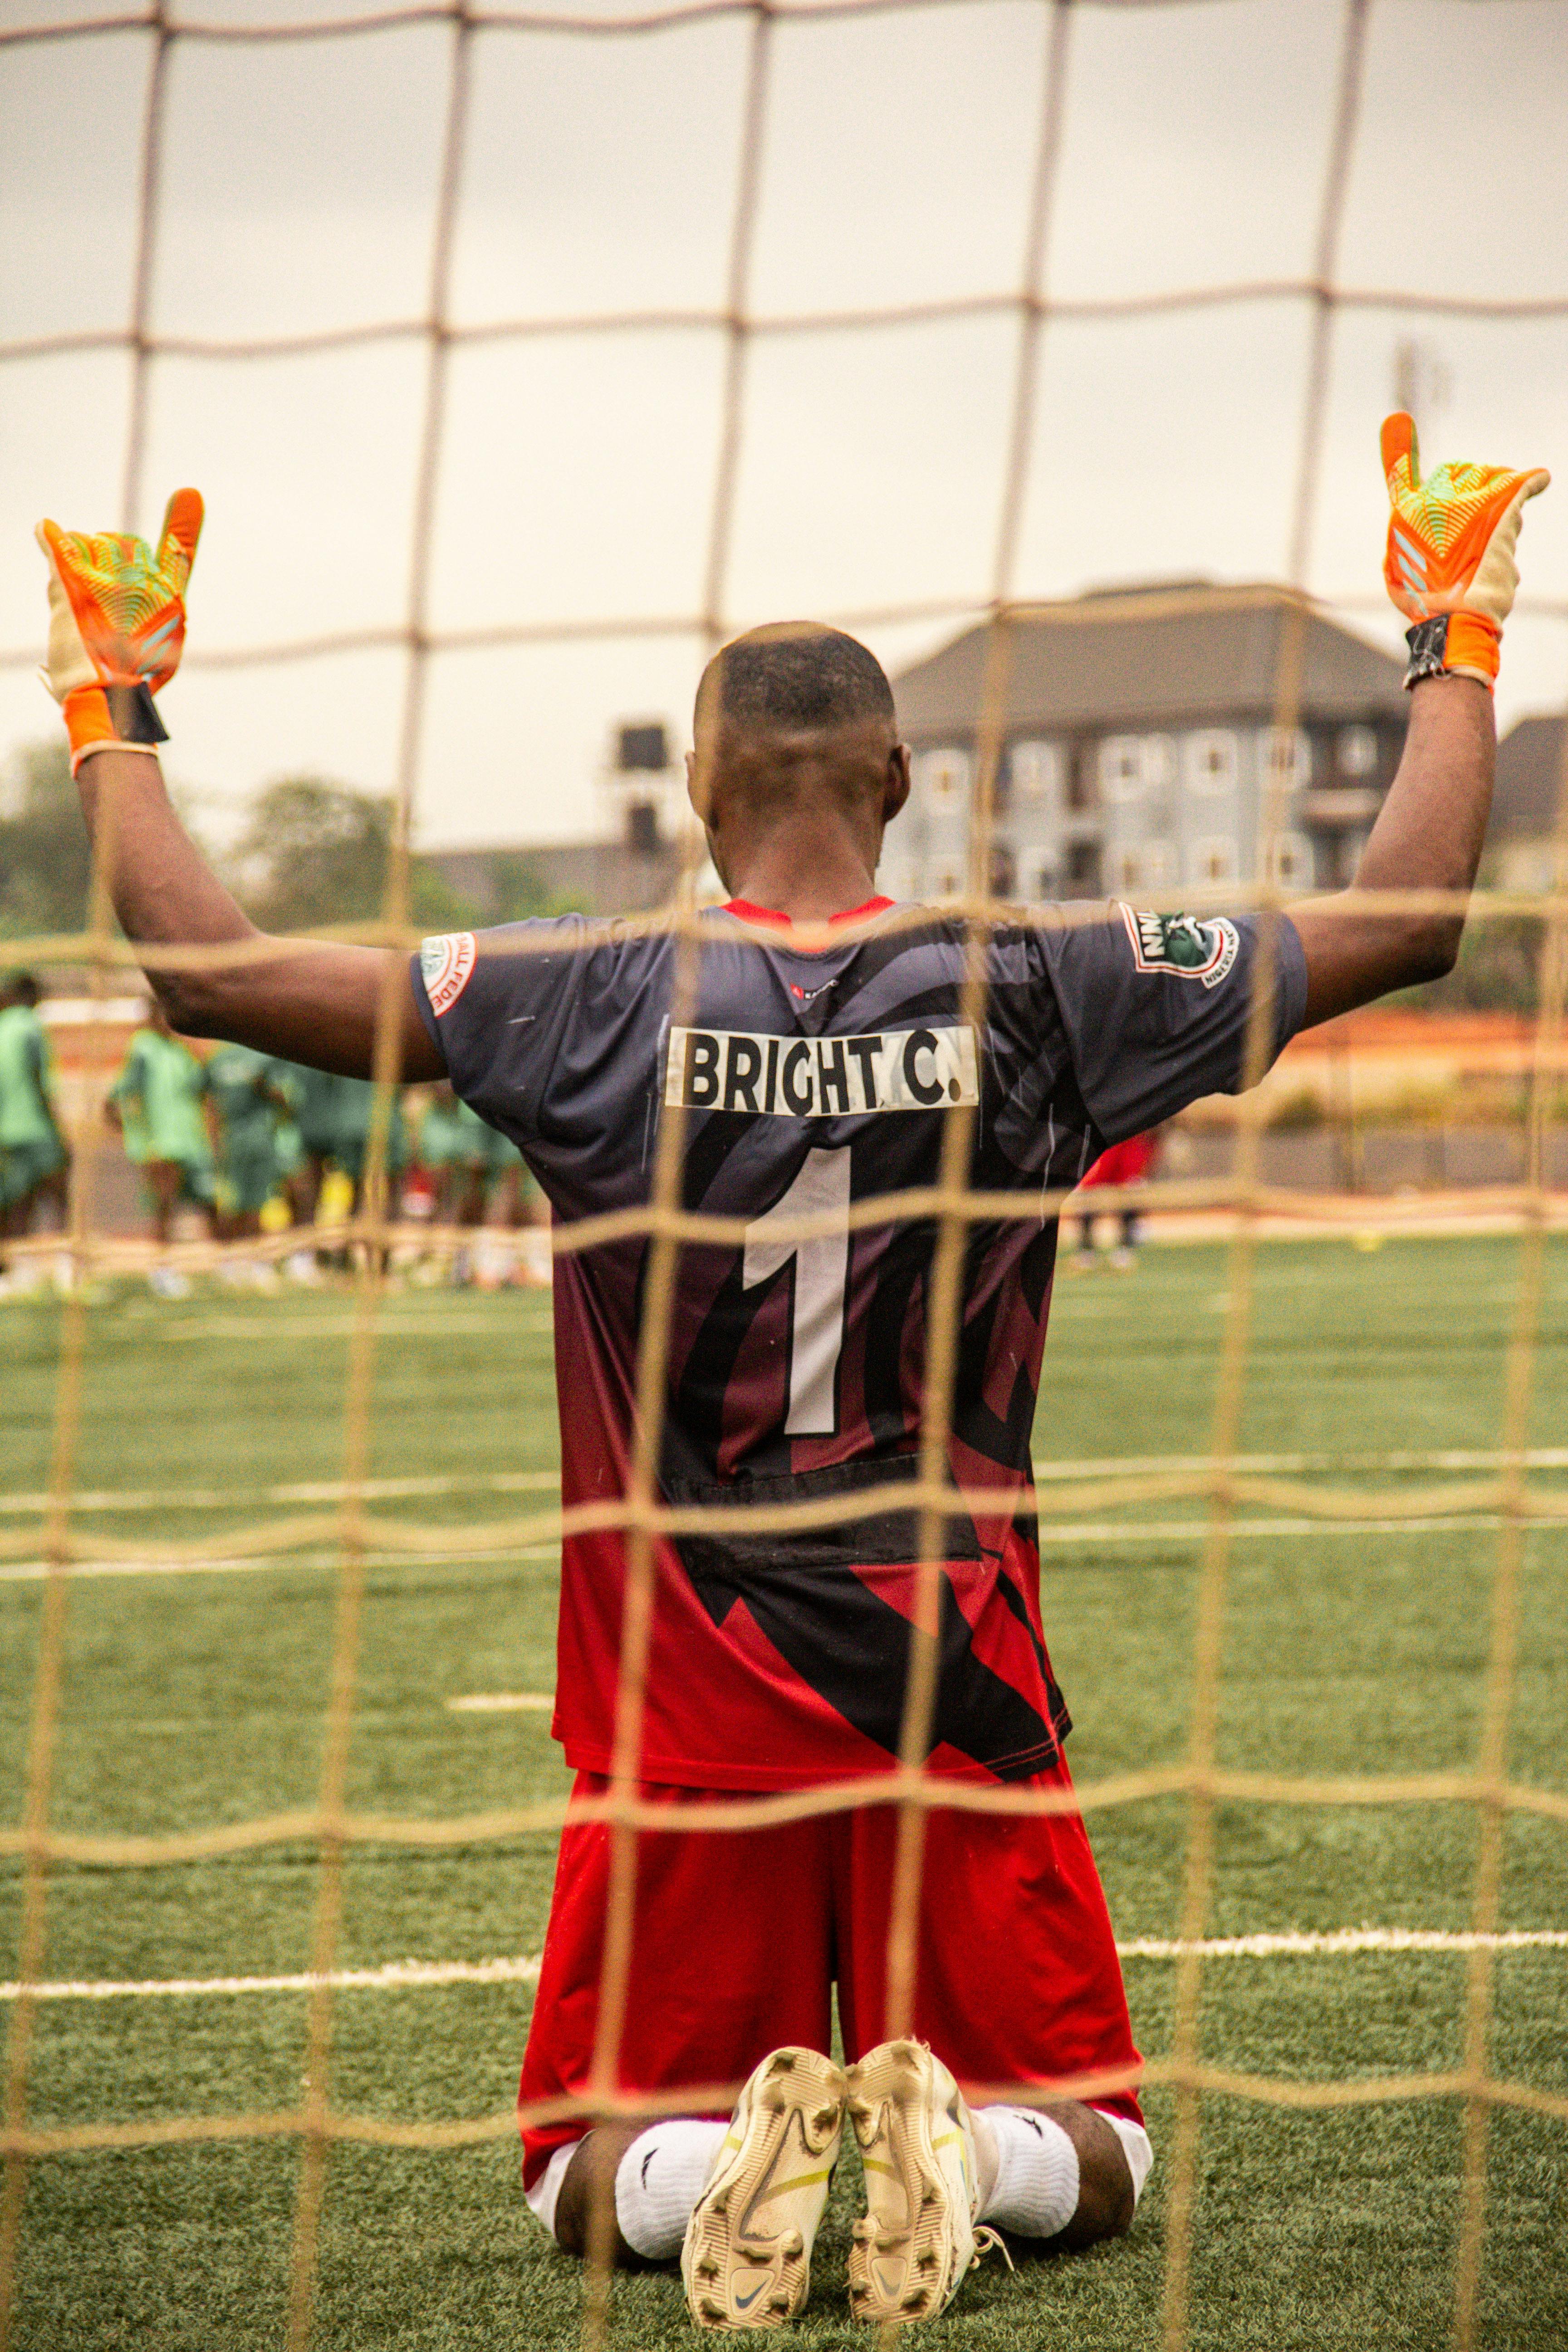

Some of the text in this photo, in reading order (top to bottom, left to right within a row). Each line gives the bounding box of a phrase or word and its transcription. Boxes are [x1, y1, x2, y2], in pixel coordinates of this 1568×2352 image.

[683, 1029, 961, 1116] BRIGHT C.
[742, 1146, 851, 1434] 1
